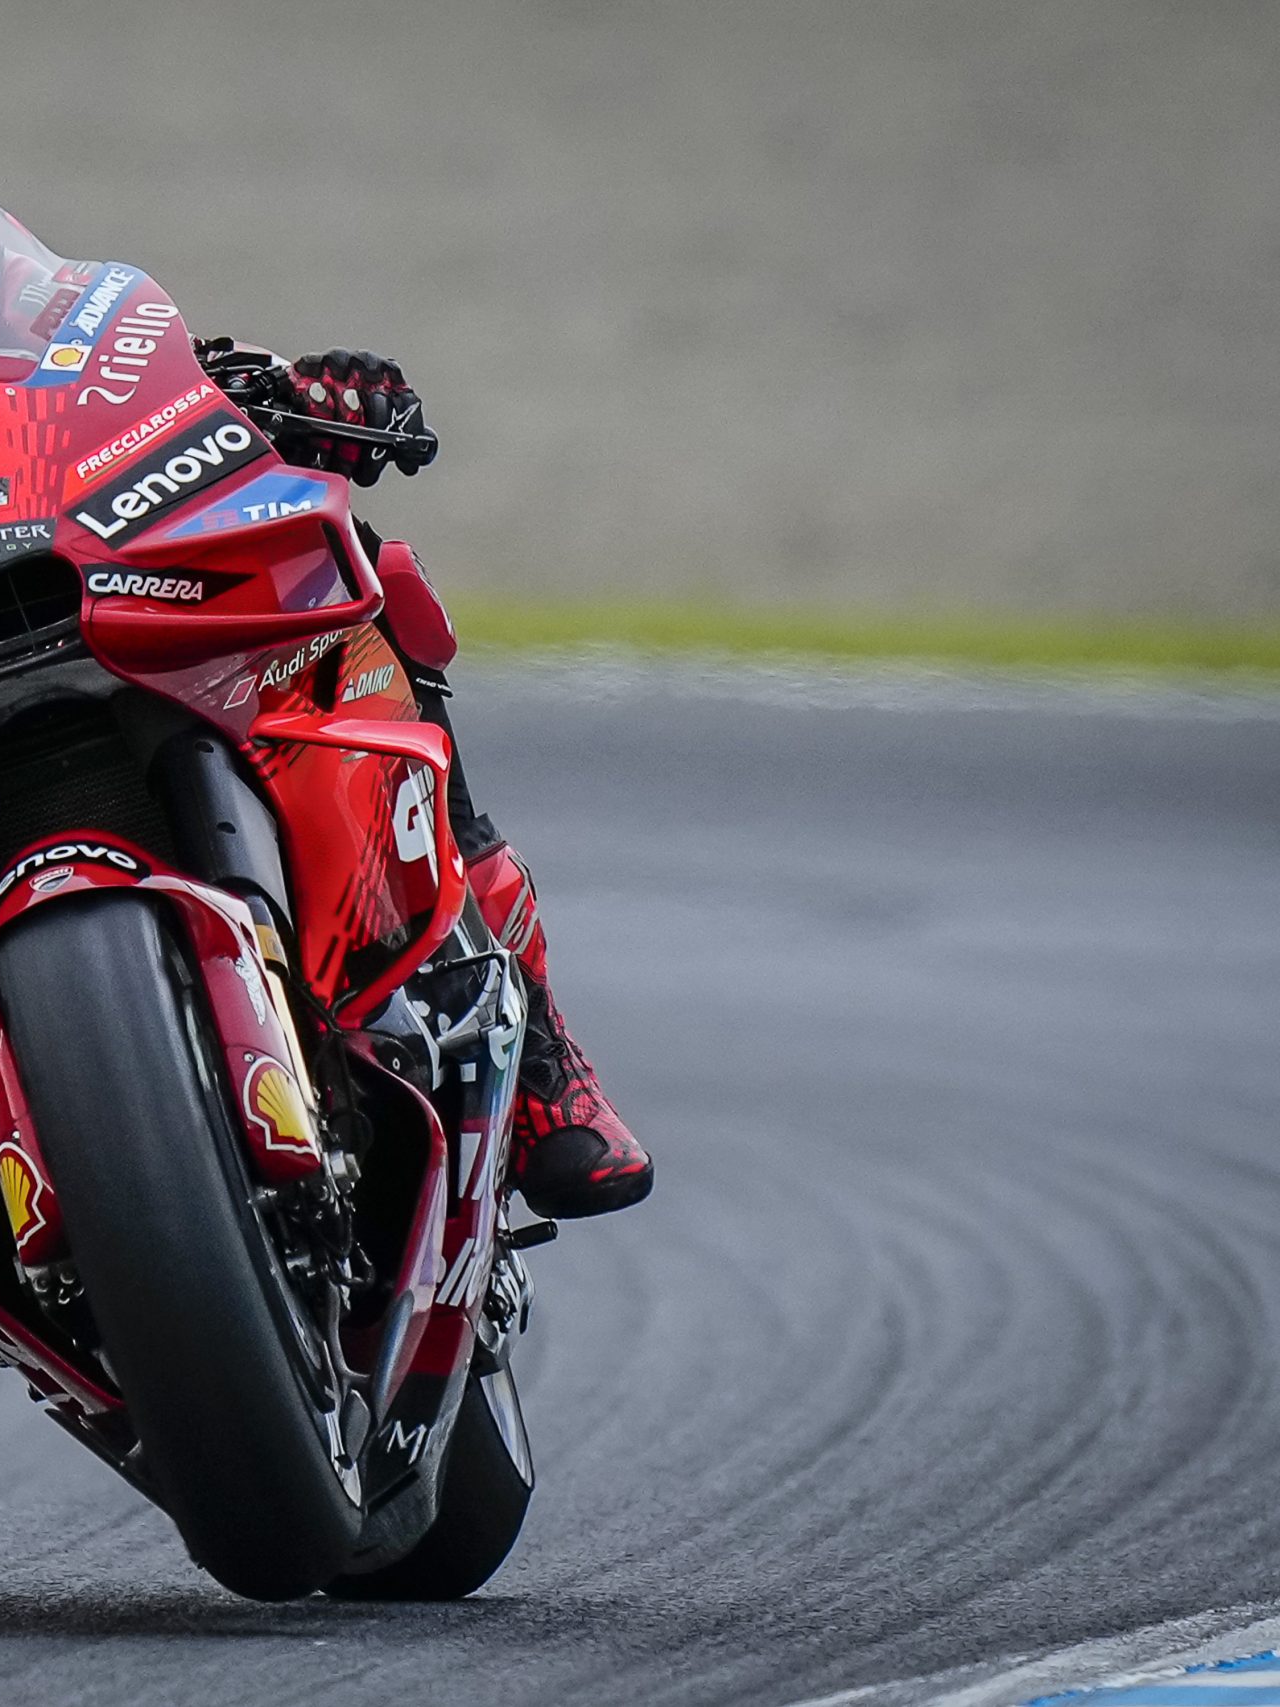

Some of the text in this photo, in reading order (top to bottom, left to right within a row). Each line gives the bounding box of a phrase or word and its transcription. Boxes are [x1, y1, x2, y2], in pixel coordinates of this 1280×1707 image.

[76, 385, 215, 479] FRECCIAROSSA
[76, 424, 252, 540] Lenovo
[242, 500, 313, 522] TIM
[87, 572, 203, 601] CARRERA
[258, 629, 342, 692] Audi Spo
